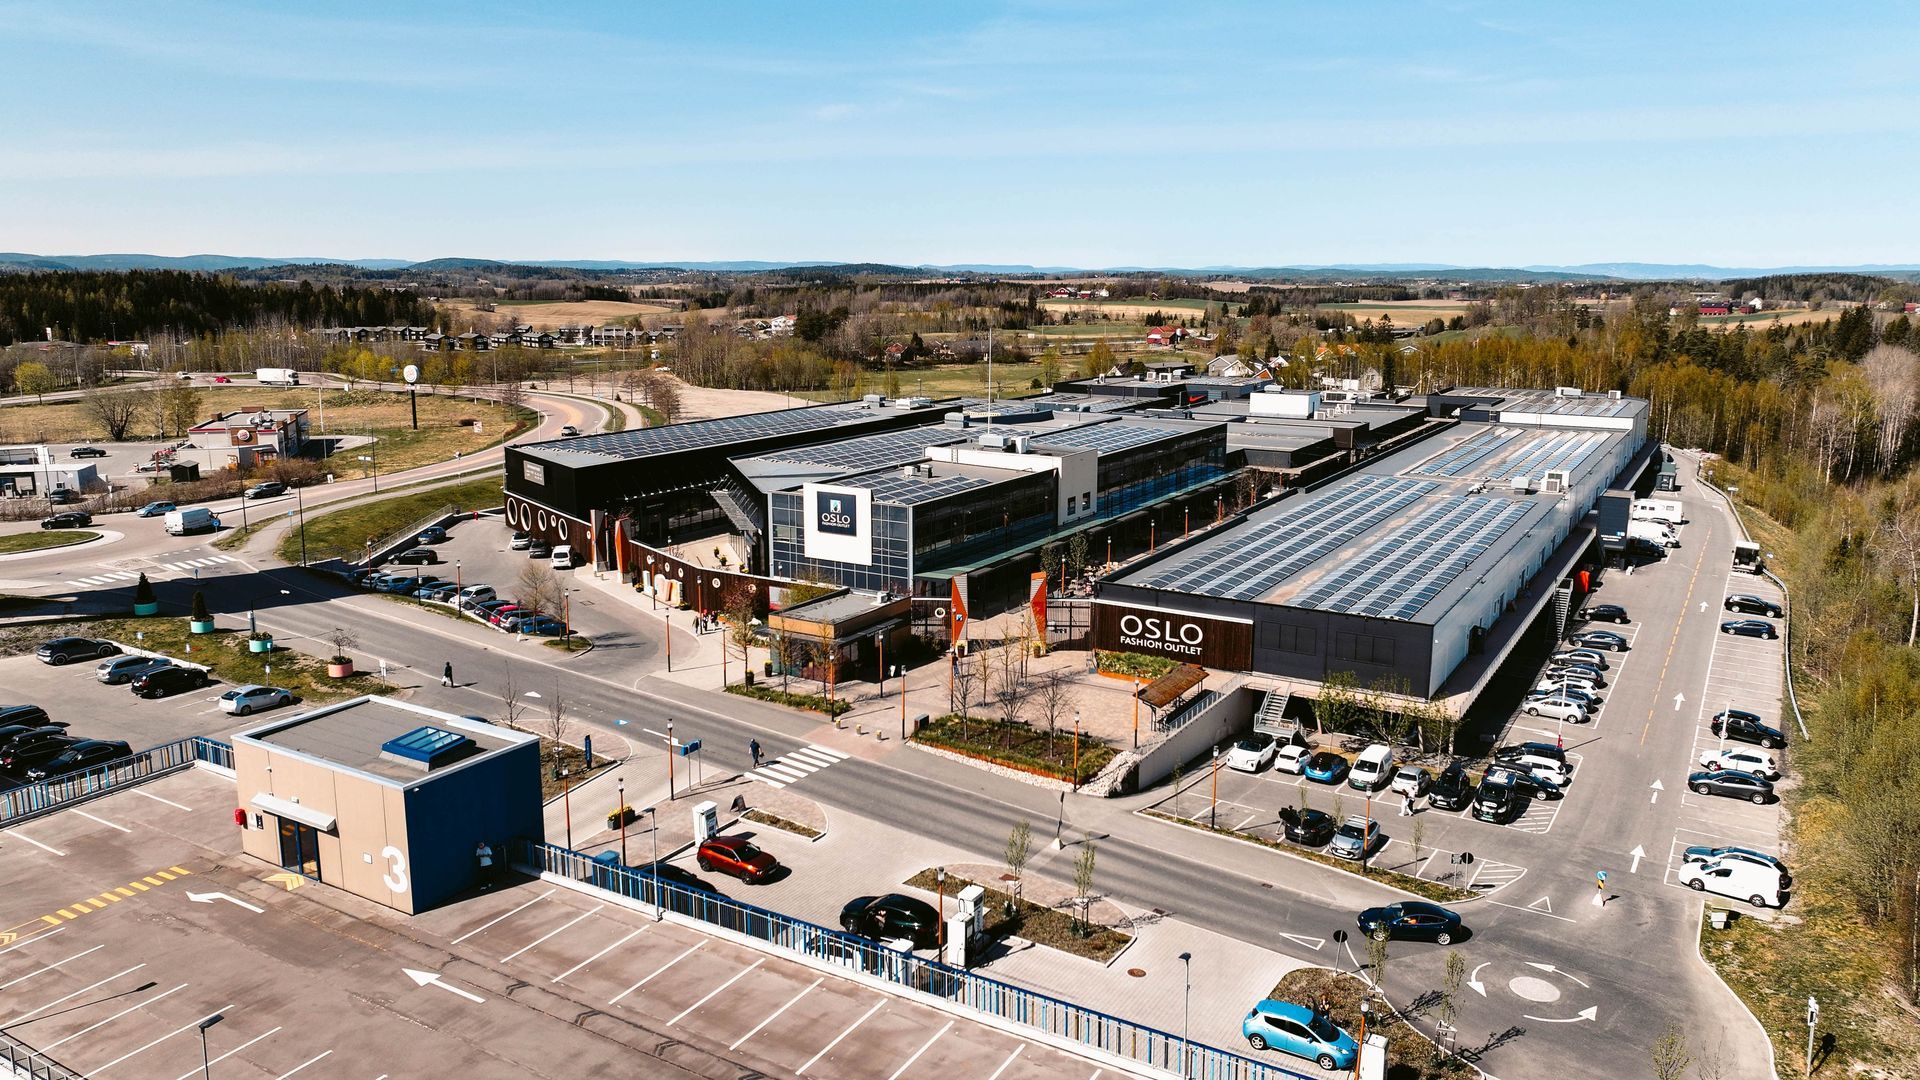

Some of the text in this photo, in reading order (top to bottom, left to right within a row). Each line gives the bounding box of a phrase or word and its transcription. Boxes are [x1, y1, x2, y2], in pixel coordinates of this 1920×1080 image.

[822, 513, 850, 524] OSLO
[1120, 615, 1203, 645] OSLO
[1120, 636, 1202, 655] FASHION OUTLET
[382, 846, 408, 893] 3
